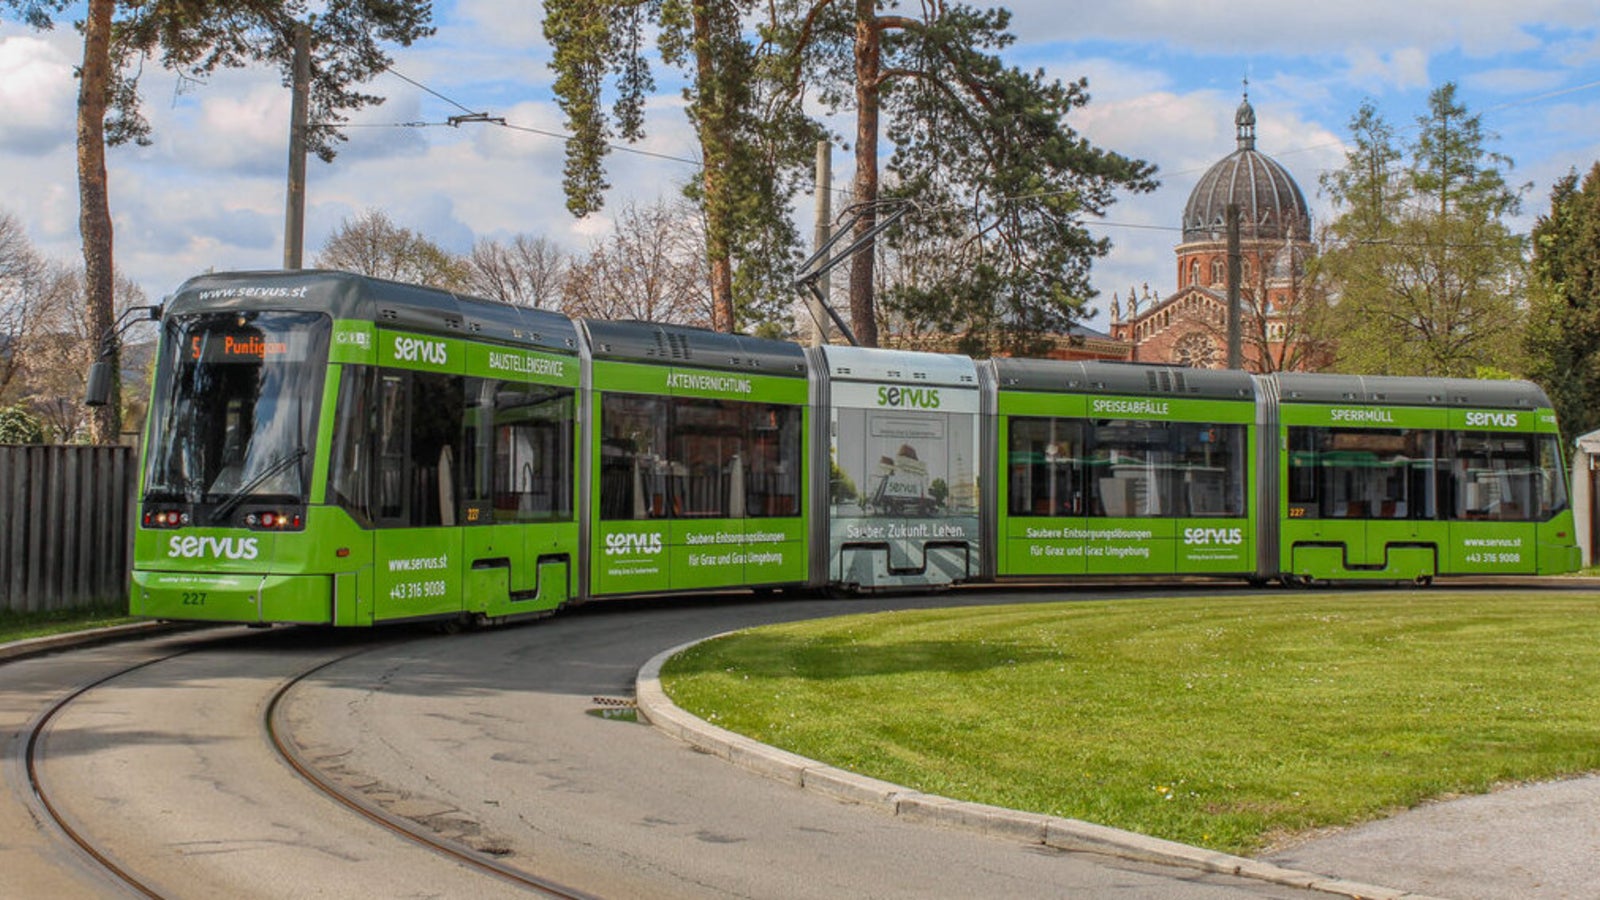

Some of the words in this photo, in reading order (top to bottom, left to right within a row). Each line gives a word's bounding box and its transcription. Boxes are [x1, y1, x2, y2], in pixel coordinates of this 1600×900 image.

[199, 286, 308, 300] www.servus.st
[192, 336, 201, 359] 5
[394, 336, 447, 365] servus
[488, 351, 564, 378] BAUSTELLENSERVICE
[666, 373, 752, 393] AKTENVERNICHTUNG
[877, 386, 940, 408] servus
[1093, 400, 1169, 415] SPEISEABFÄLLE
[1330, 408, 1394, 423] SPERRMÜLL
[1465, 412, 1519, 427] servus
[1289, 508, 1305, 518] 227
[933, 524, 965, 538] Leben.
[1184, 528, 1241, 544] servus
[168, 535, 259, 560] servus
[605, 532, 662, 555] servus
[1464, 538, 1521, 547] www.servus.st
[1045, 545, 1065, 556] Graz
[1066, 545, 1082, 556] und
[1465, 553, 1480, 562] +43
[1499, 553, 1520, 562] 9008
[389, 553, 448, 571] www.servus.st
[390, 582, 406, 599] +43
[408, 582, 422, 597] 316
[424, 581, 446, 596] 9008
[182, 593, 207, 605] 227
